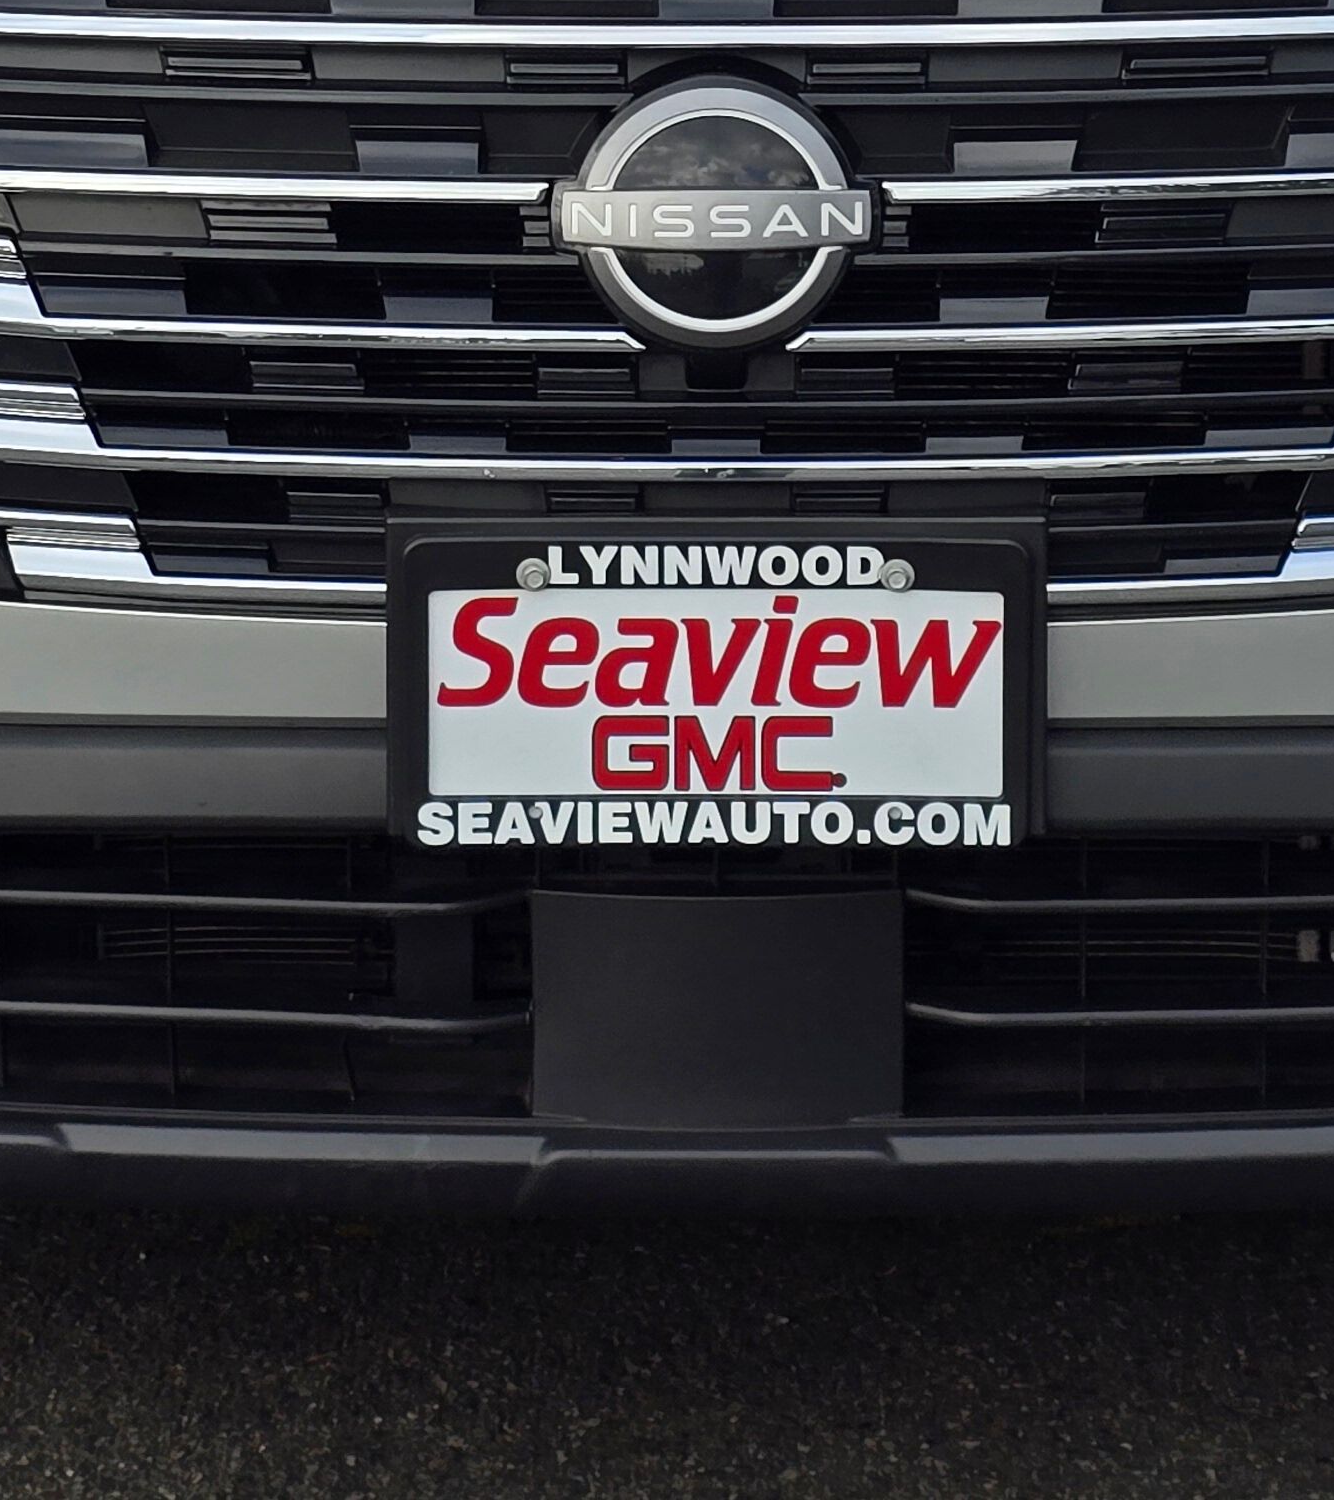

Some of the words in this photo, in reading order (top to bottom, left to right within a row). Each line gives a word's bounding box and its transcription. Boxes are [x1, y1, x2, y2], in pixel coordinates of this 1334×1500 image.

[570, 201, 864, 238] NISSAN
[547, 545, 886, 587] LYNNWOOD
[436, 594, 1003, 709] Seaview
[416, 800, 1013, 847] SEAVIEWAUTO.COM
